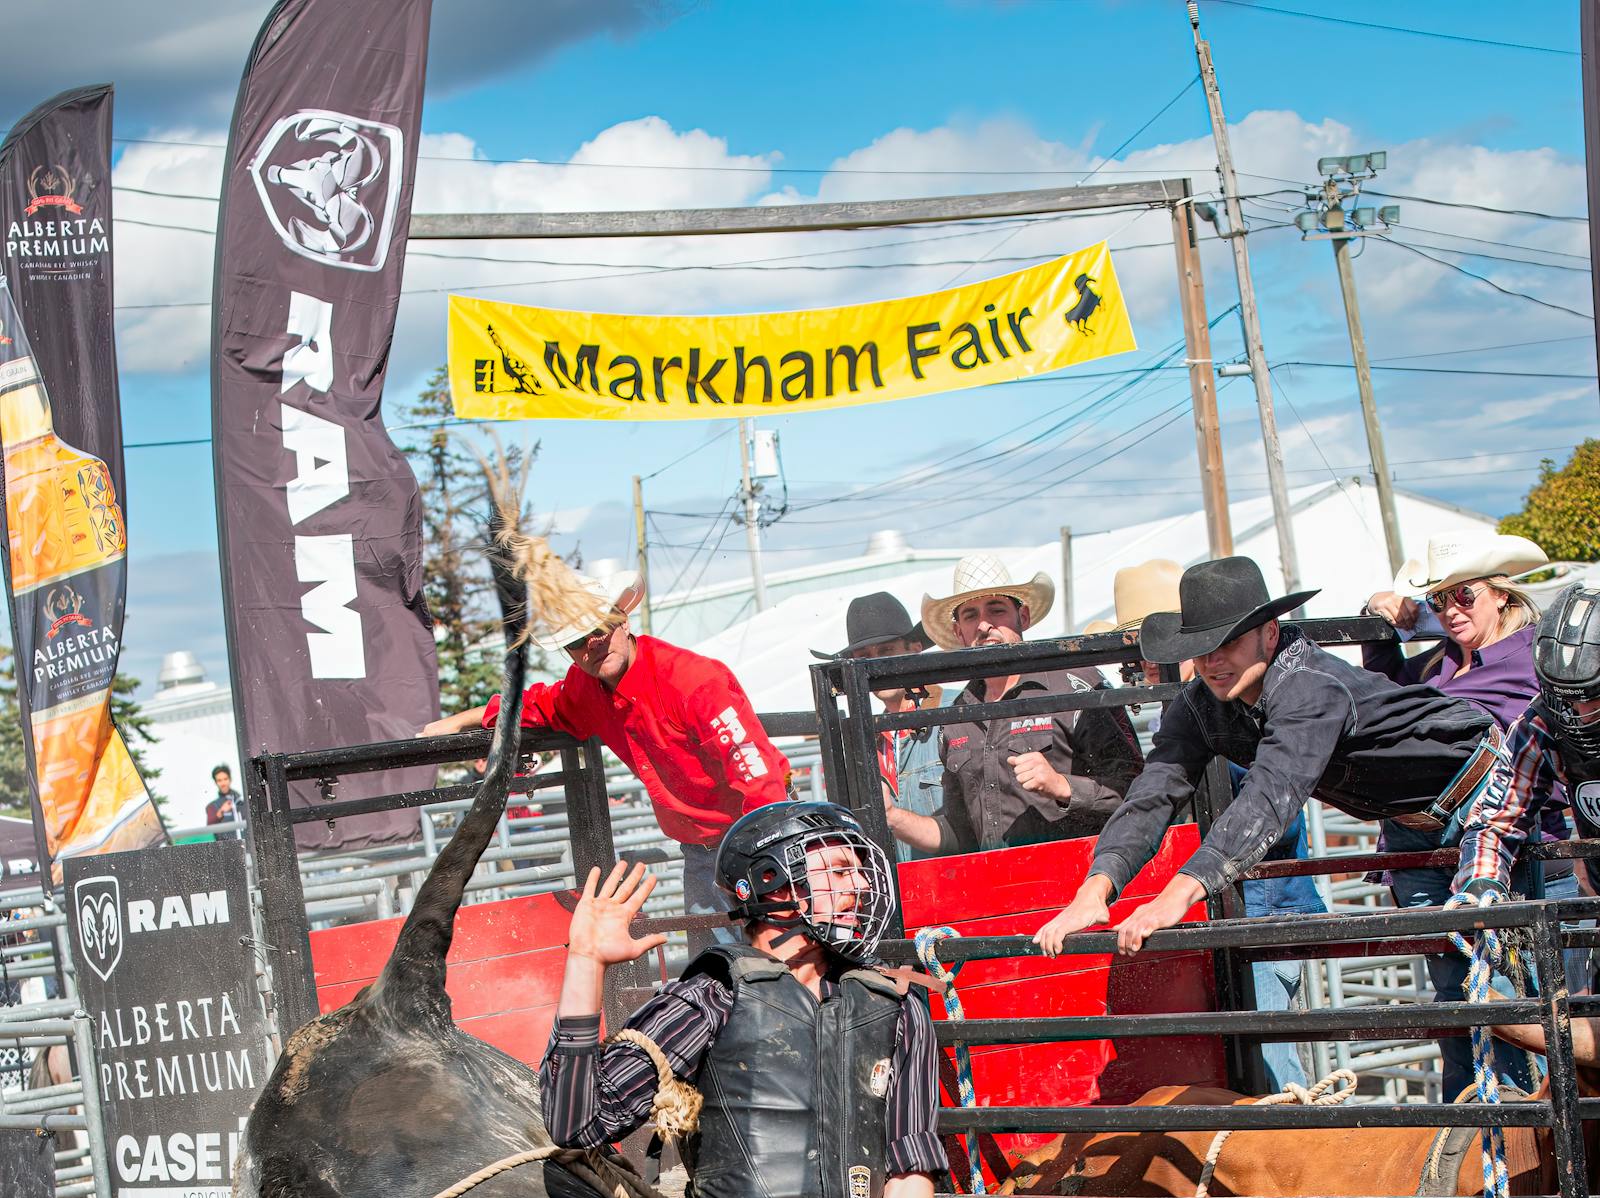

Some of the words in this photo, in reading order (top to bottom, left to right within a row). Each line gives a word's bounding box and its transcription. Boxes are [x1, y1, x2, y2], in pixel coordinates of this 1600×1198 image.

[6, 236, 109, 258] PREMIUM
[8, 218, 105, 238] ALBERTA
[543, 339, 885, 405] Markham
[906, 303, 1034, 380] Fair
[281, 290, 367, 680] RAM
[34, 626, 116, 665] ALBERTA
[34, 641, 118, 683] PREMIUM
[1553, 686, 1585, 696] Reebok
[1011, 717, 1053, 731] RAM
[756, 832, 781, 848] CCM
[127, 890, 230, 933] RAM
[101, 994, 241, 1049] ALBERTA
[102, 1049, 255, 1102] PREMIUM
[116, 1132, 222, 1183] CASE
